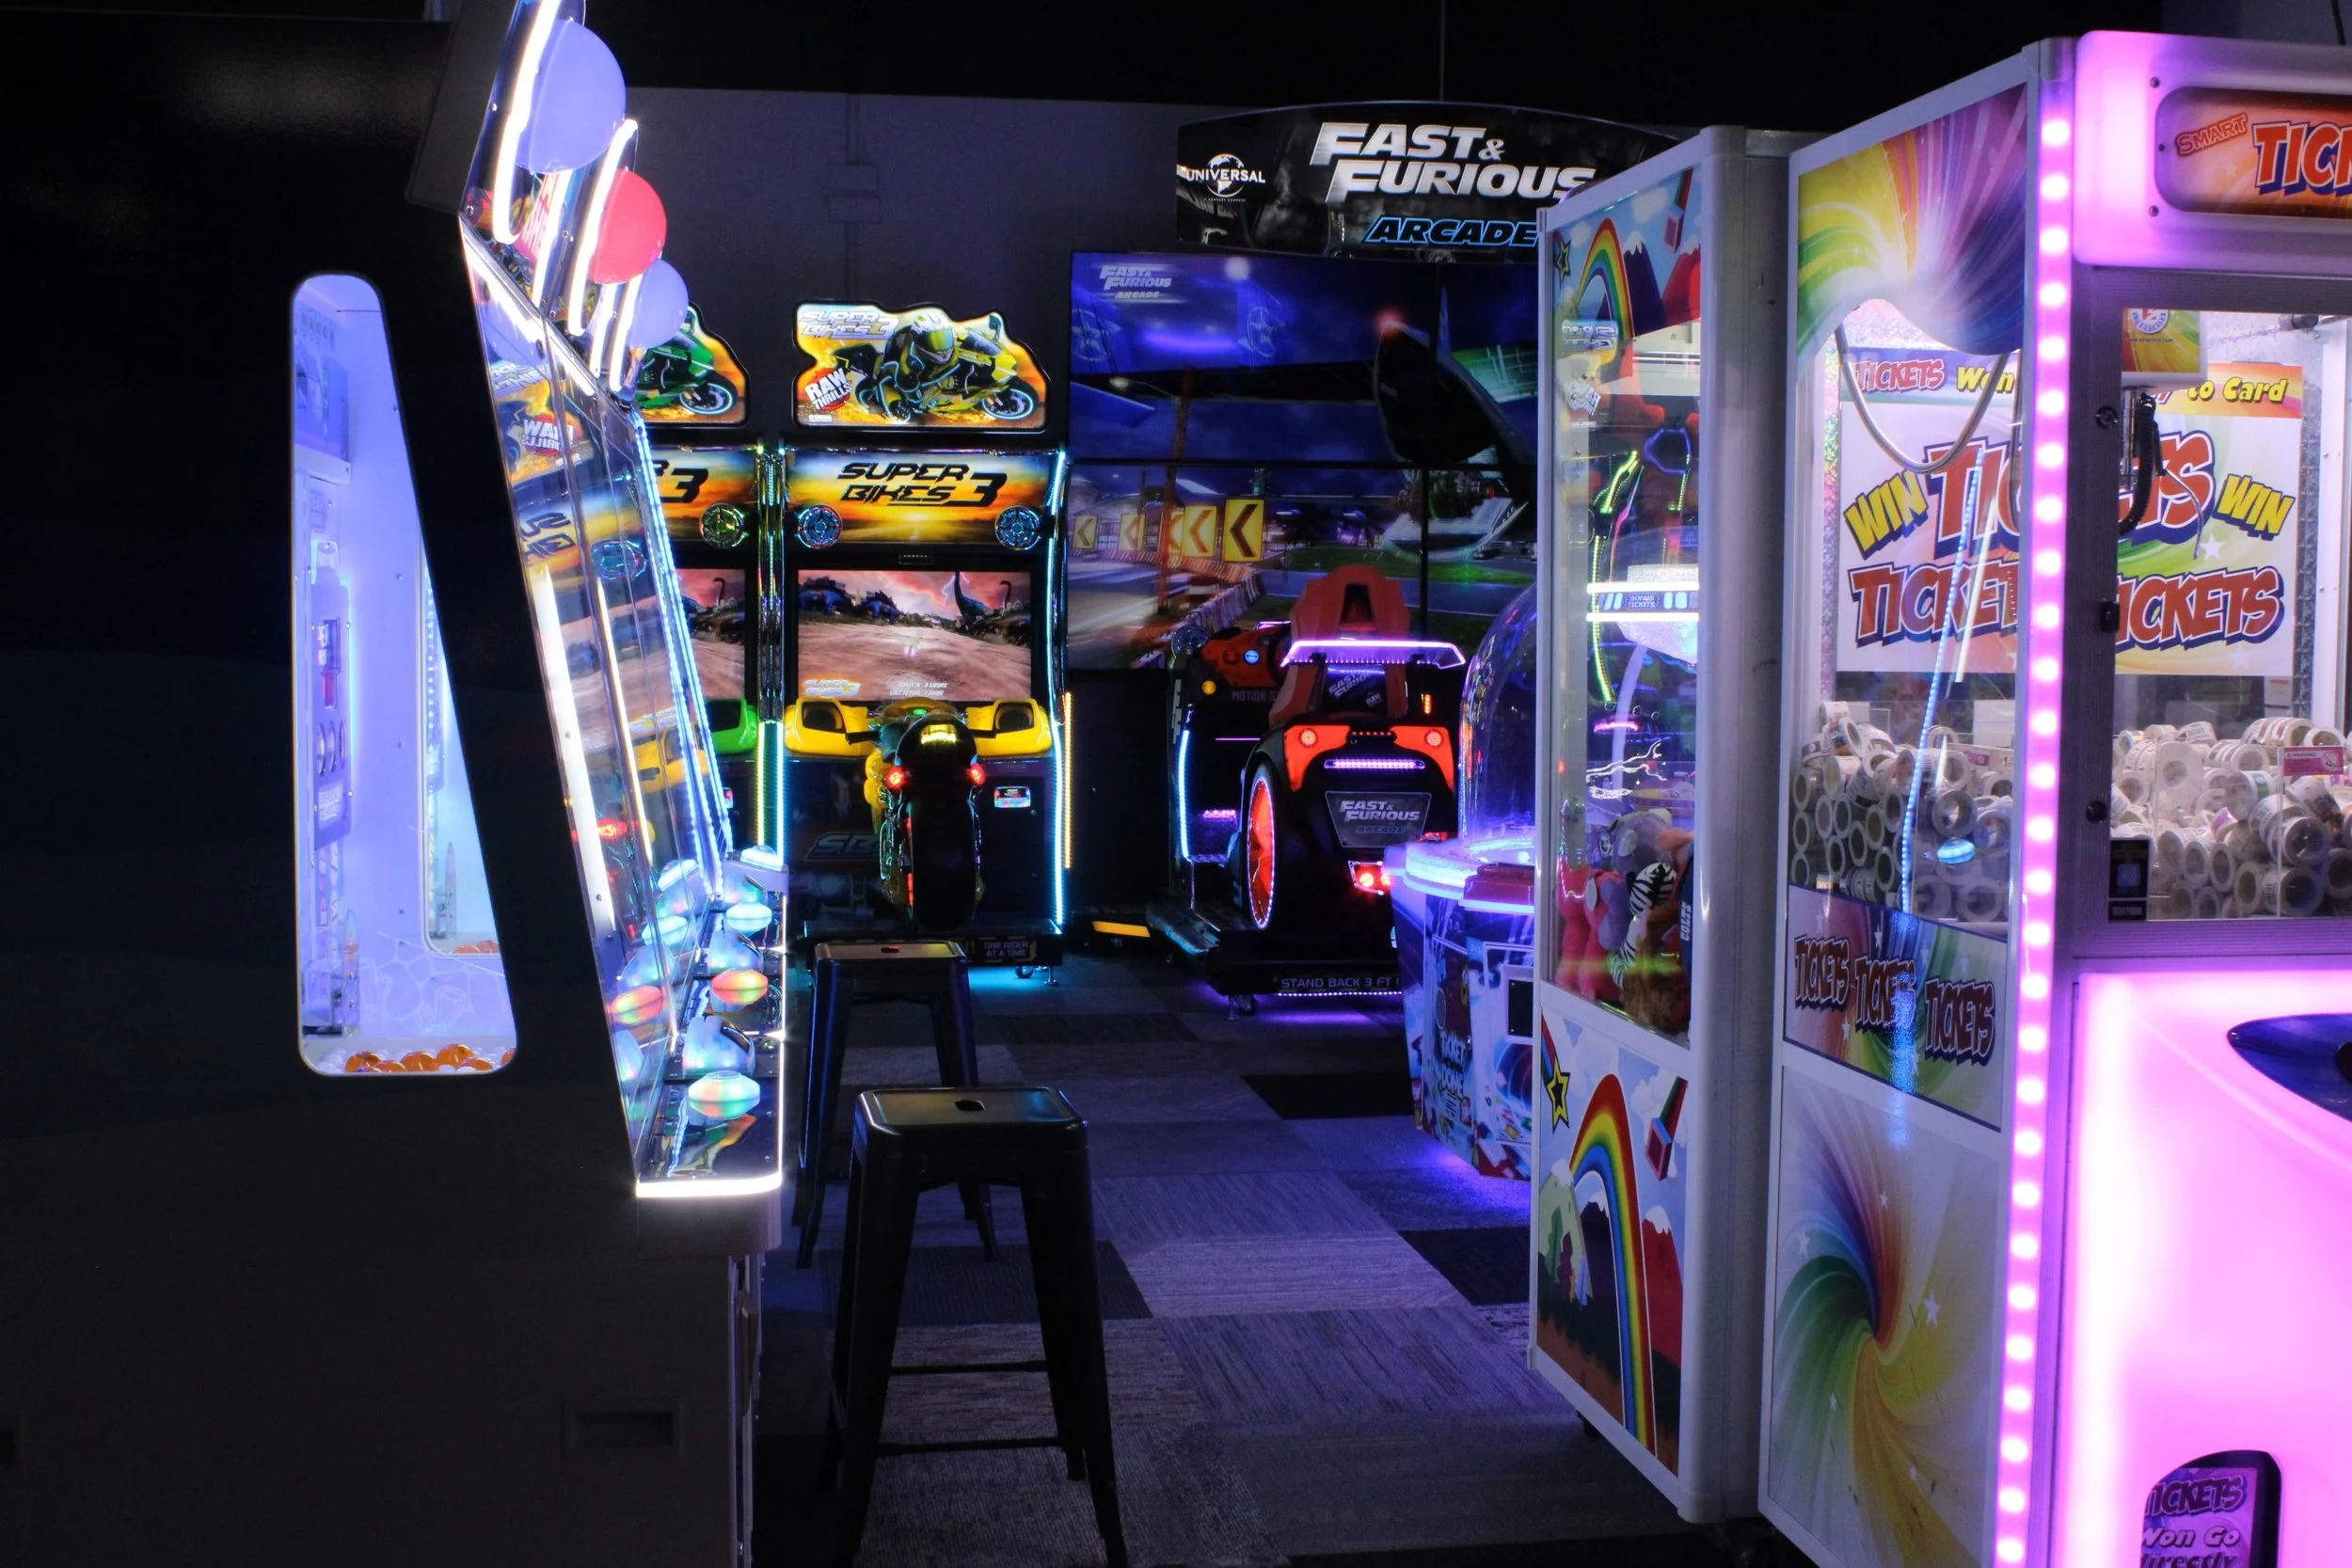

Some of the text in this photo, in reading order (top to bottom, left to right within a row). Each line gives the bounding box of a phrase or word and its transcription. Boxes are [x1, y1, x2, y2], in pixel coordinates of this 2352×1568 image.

[1310, 122, 1505, 166] FAST &
[2175, 112, 2249, 157] SMART
[1186, 168, 1265, 183] UNIVERSAL
[1325, 159, 1597, 203] FURIOUS
[1364, 217, 1539, 246] ARCADE
[1099, 265, 1145, 279] FAST
[1104, 277, 1172, 291] FURIOUS
[799, 310, 880, 325] SUPER
[802, 324, 875, 339] BIKES
[804, 368, 848, 402] RAW
[1851, 358, 1945, 393] TICKETS
[2223, 377, 2288, 404] Card
[812, 382, 852, 410] THRILLS
[660, 467, 708, 503] 3
[836, 462, 969, 483] SUPER
[839, 484, 958, 505] BIKES
[2212, 473, 2296, 541] WIN
[1843, 470, 1929, 560] WIN
[1848, 562, 2284, 651] TICKET ICKETS
[1340, 800, 1388, 813] FAST
[1343, 810, 1421, 823] FURIOUS
[1680, 900, 1692, 942] COLTS
[1281, 978, 1324, 989] STAND
[1328, 977, 1360, 988] BACK
[1364, 977, 1372, 987] 3
[1376, 976, 1392, 987] FT
[1794, 935, 1851, 1013] TICKETS
[1925, 977, 1995, 1067] TICKETS
[2204, 1525, 2241, 1547] Go
